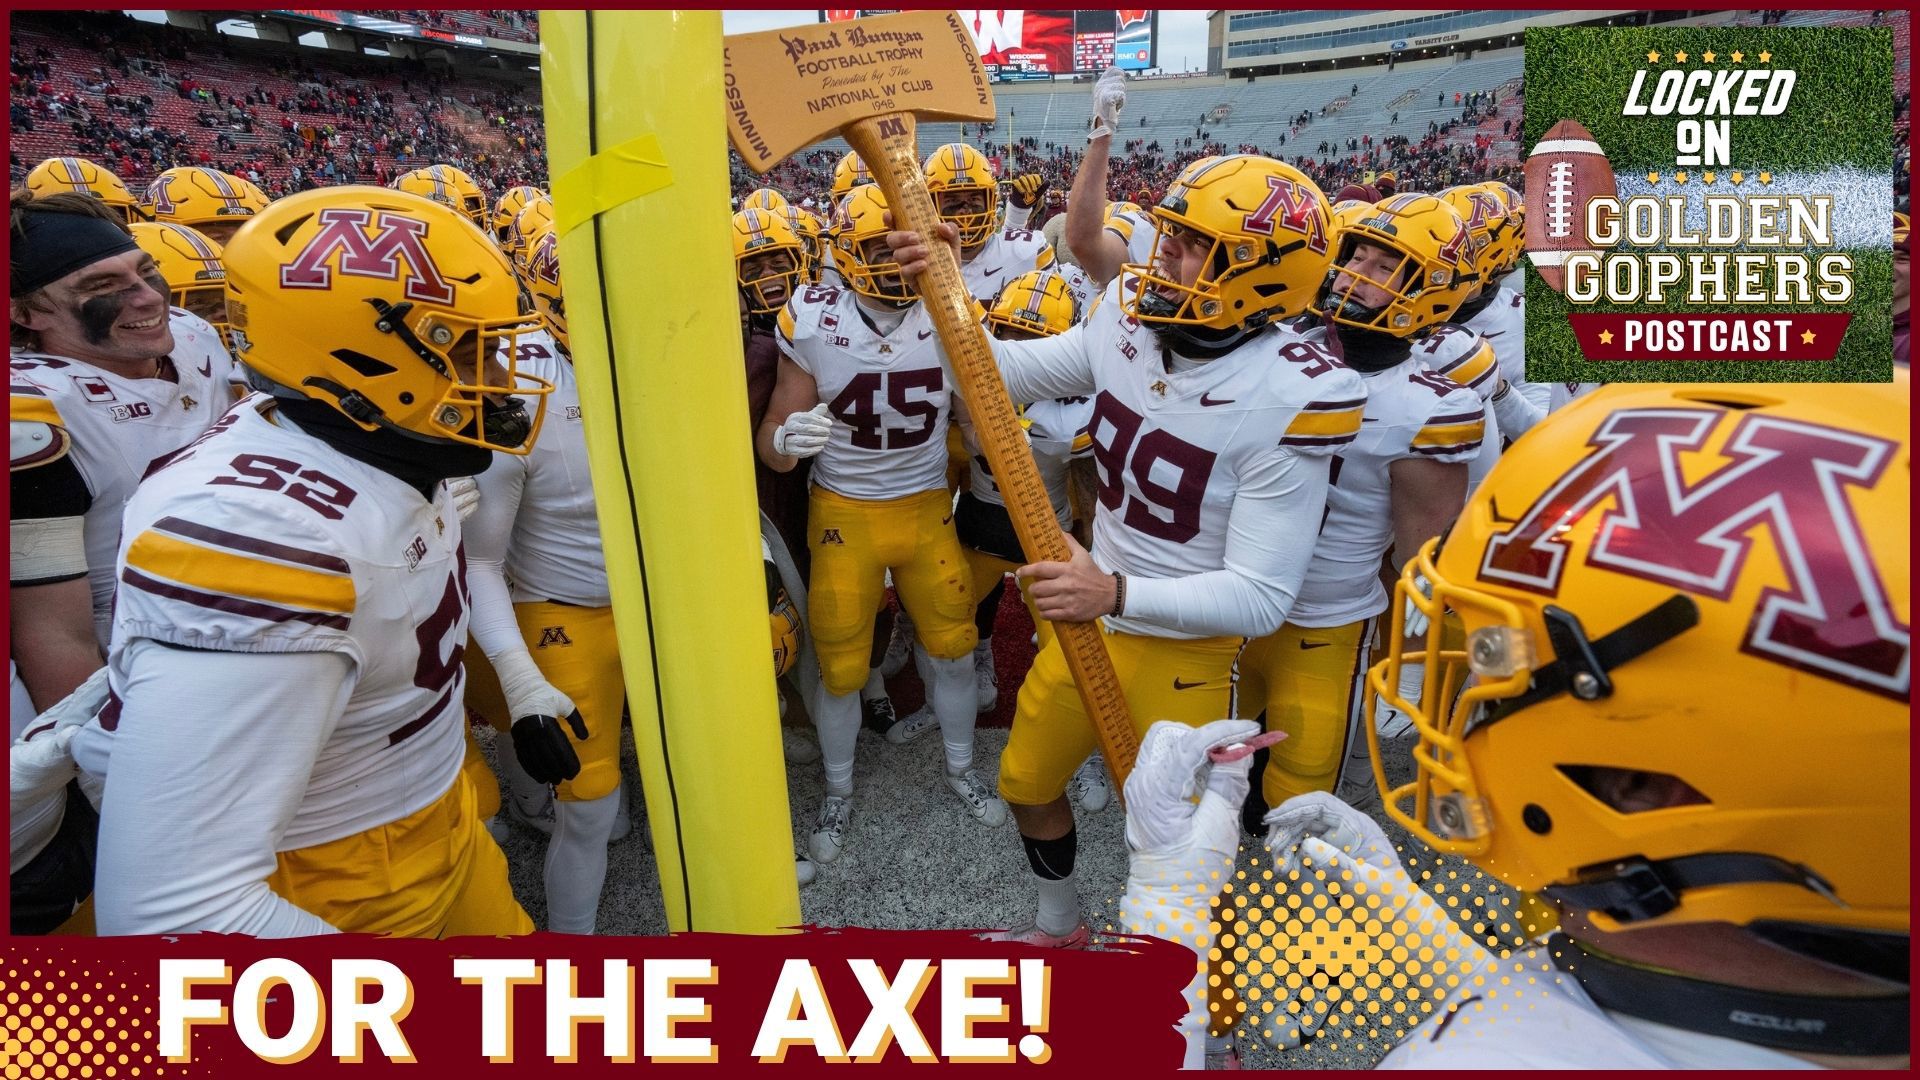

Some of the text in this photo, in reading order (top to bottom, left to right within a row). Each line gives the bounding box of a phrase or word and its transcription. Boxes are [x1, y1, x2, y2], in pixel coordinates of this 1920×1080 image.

[421, 29, 483, 45] WISCONSIN BADGERS
[779, 26, 924, 64] Paul Bunyan
[796, 48, 924, 78] FOOTBALL TROPHY
[821, 65, 911, 89] Presented by The
[945, 14, 988, 105] WISCONSIN
[806, 79, 934, 114] NATIONAL W CLUB
[872, 99, 895, 111] 1948
[877, 117, 908, 140] M
[827, 367, 944, 450] 45
[1088, 389, 1218, 544] 99
[206, 453, 358, 520] 52
